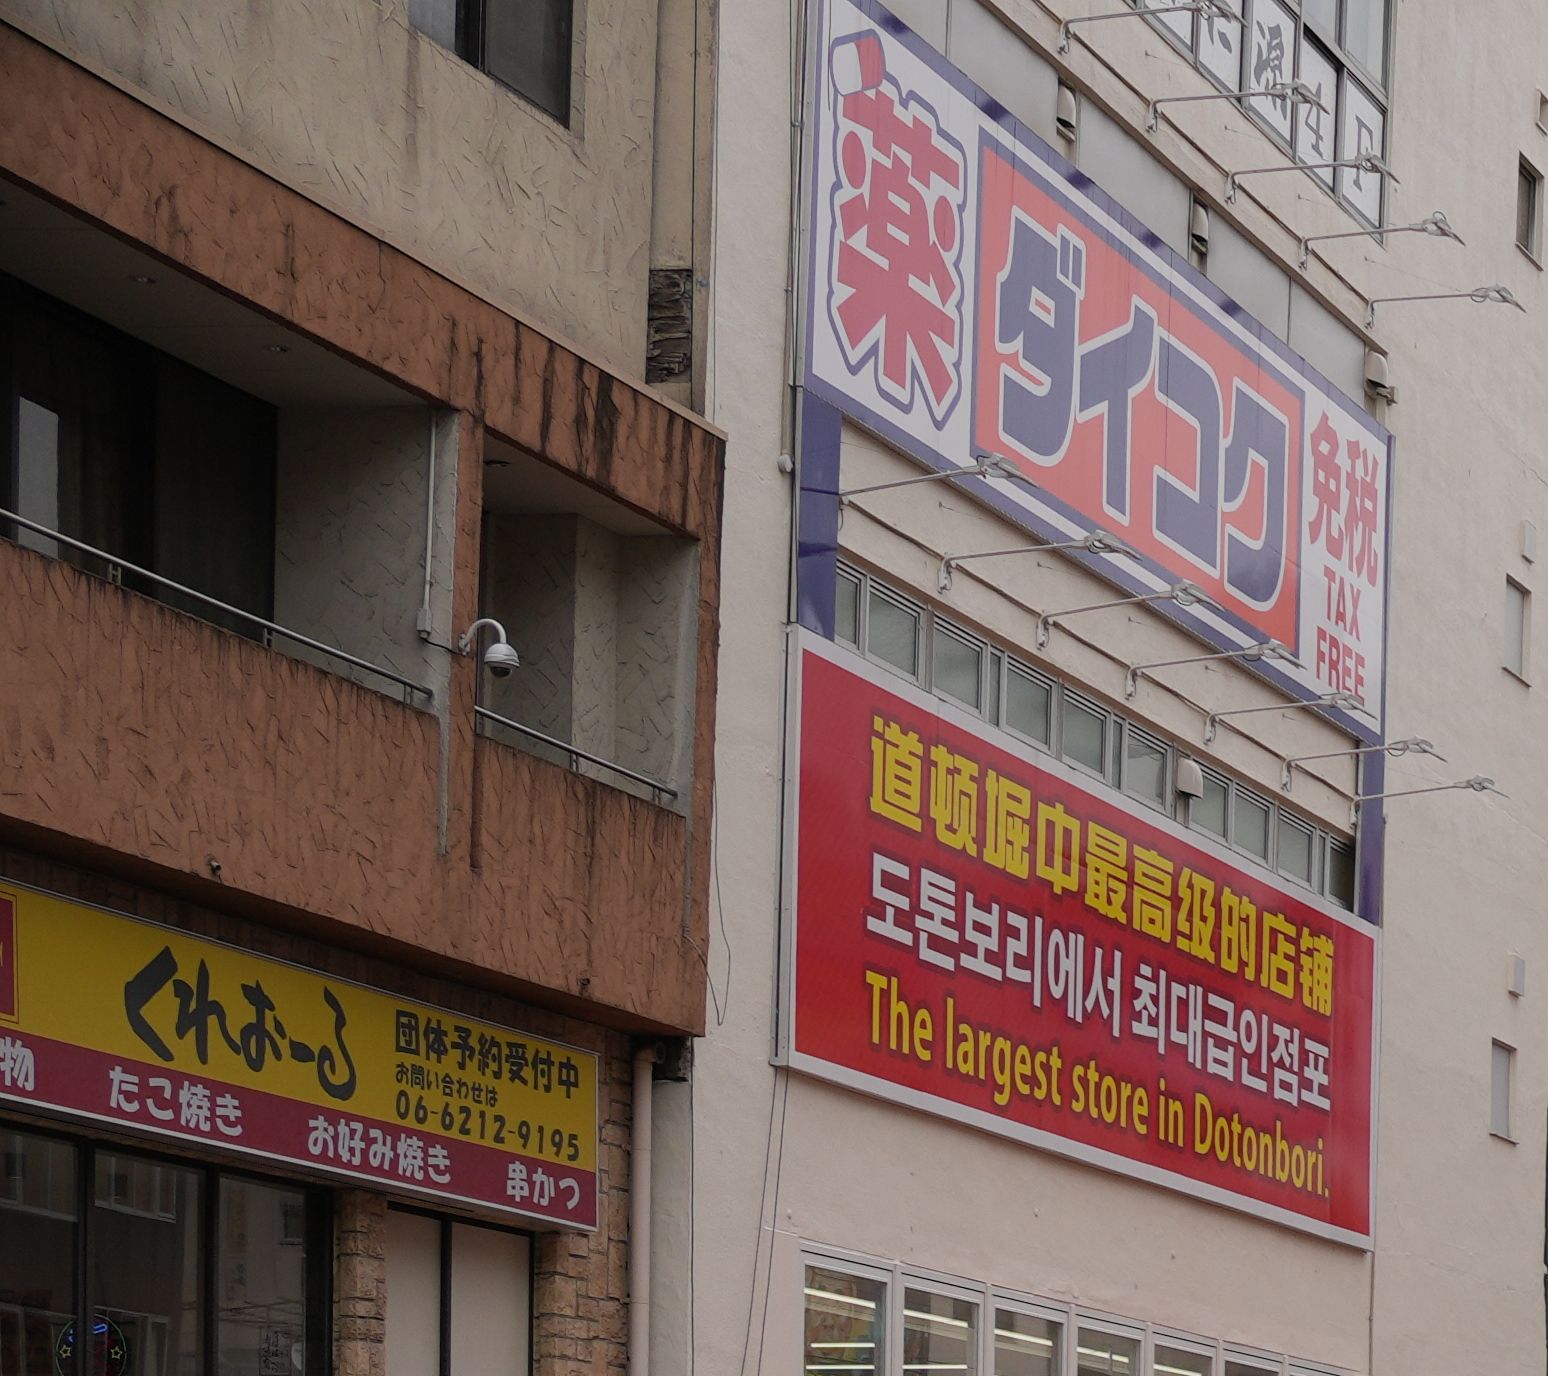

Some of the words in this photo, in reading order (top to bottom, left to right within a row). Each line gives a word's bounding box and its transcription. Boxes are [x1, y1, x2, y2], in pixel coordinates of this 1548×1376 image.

[832, 32, 964, 420] 薬
[998, 205, 1290, 604] ダイコク
[1309, 408, 1381, 586] 免税
[1315, 629, 1368, 707] FREE
[1325, 562, 1362, 639] TAX
[395, 1009, 580, 1100] 団体予約受付中
[866, 853, 1122, 1037] 도톤보리에서
[1132, 961, 1331, 1110] 최대급인점포
[109, 1065, 243, 1138] たこ焼き
[308, 1114, 453, 1186] お好み焼き
[506, 1162, 582, 1211] 串かつ
[396, 1062, 499, 1108] お問い合わせは
[396, 1089, 581, 1163] 06-6212-9195
[866, 970, 932, 1062] The
[945, 998, 1061, 1106] largest
[1072, 1058, 1149, 1136] store
[1158, 1078, 1184, 1147] in
[1194, 1092, 1330, 1198] Dotonbori.
